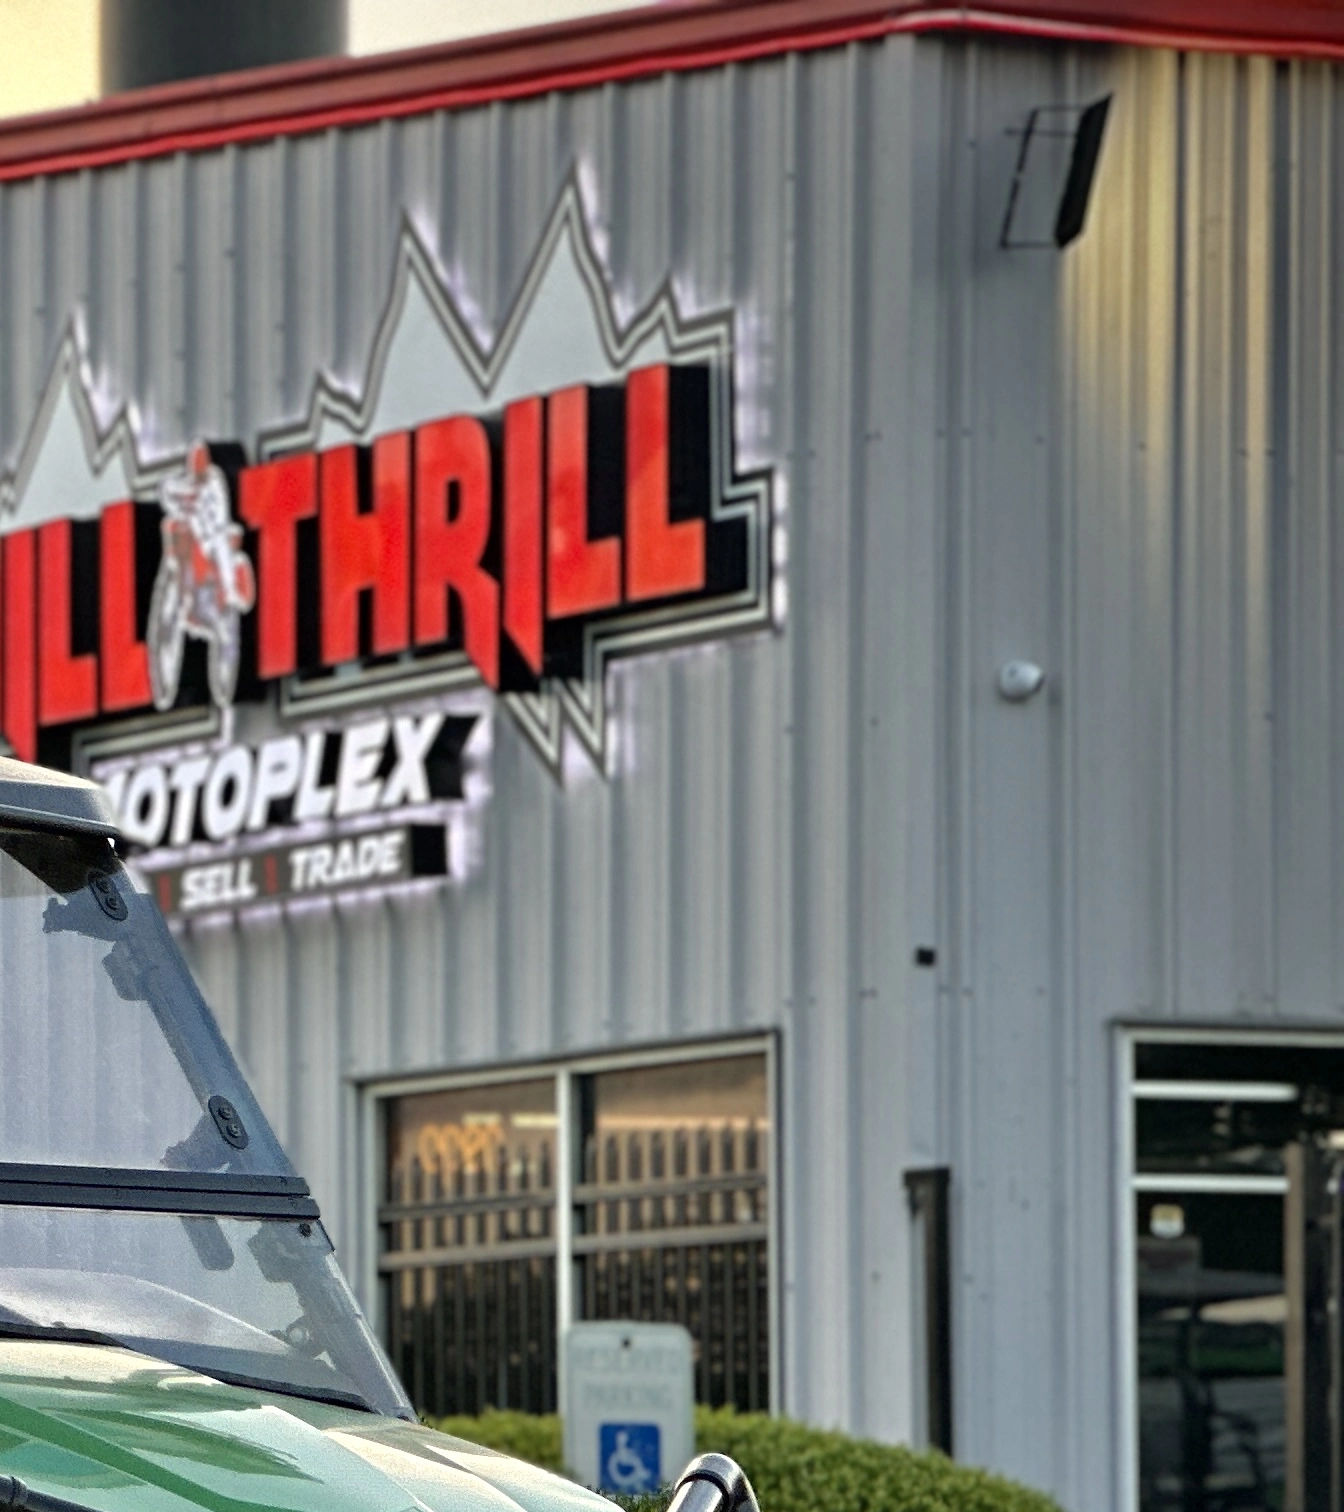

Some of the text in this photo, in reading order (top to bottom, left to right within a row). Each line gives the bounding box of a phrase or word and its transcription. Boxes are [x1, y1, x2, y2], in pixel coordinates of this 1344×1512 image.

[238, 361, 706, 690] THRILL
[104, 711, 446, 847] OTOPLEX
[179, 833, 407, 910] SELL TRADE
